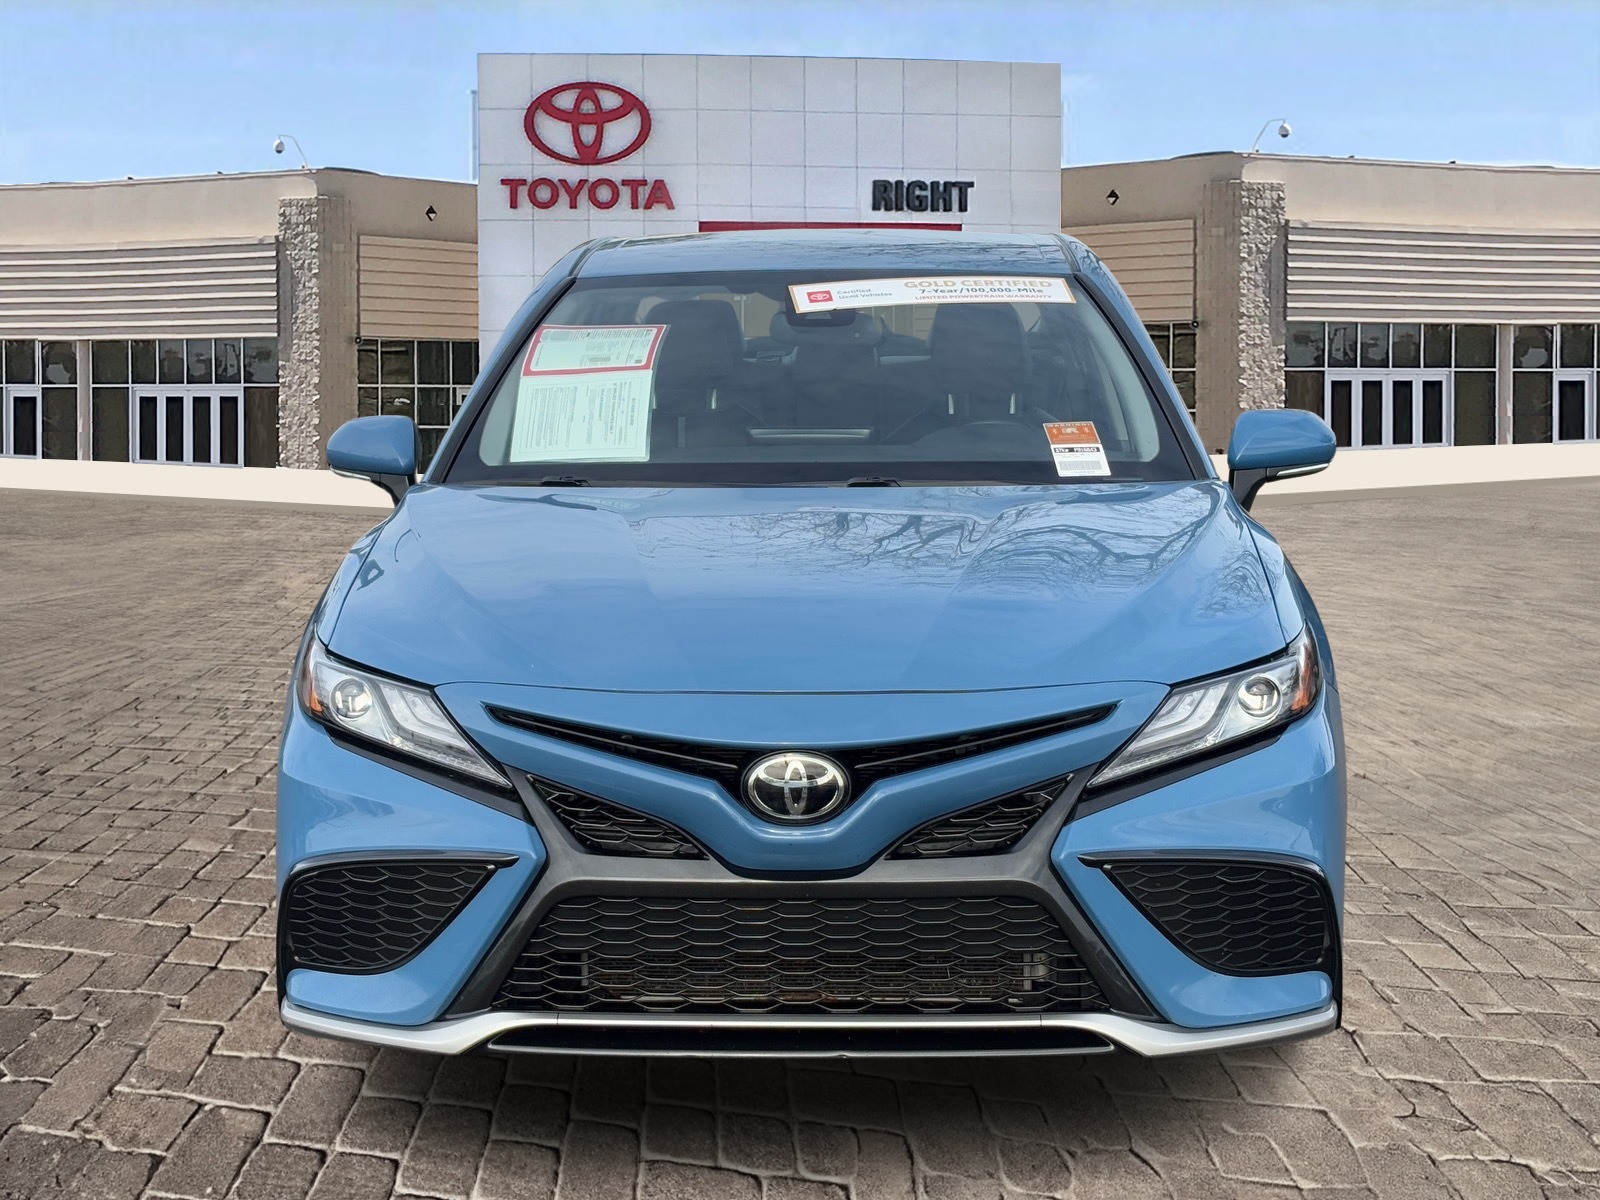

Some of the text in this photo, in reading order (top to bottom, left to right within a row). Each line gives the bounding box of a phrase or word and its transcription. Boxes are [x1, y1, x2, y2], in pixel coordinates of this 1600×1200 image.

[500, 178, 675, 210] TOYOTA
[872, 180, 974, 212] RIGHT
[904, 280, 1052, 288] GOLD CERTIFIED
